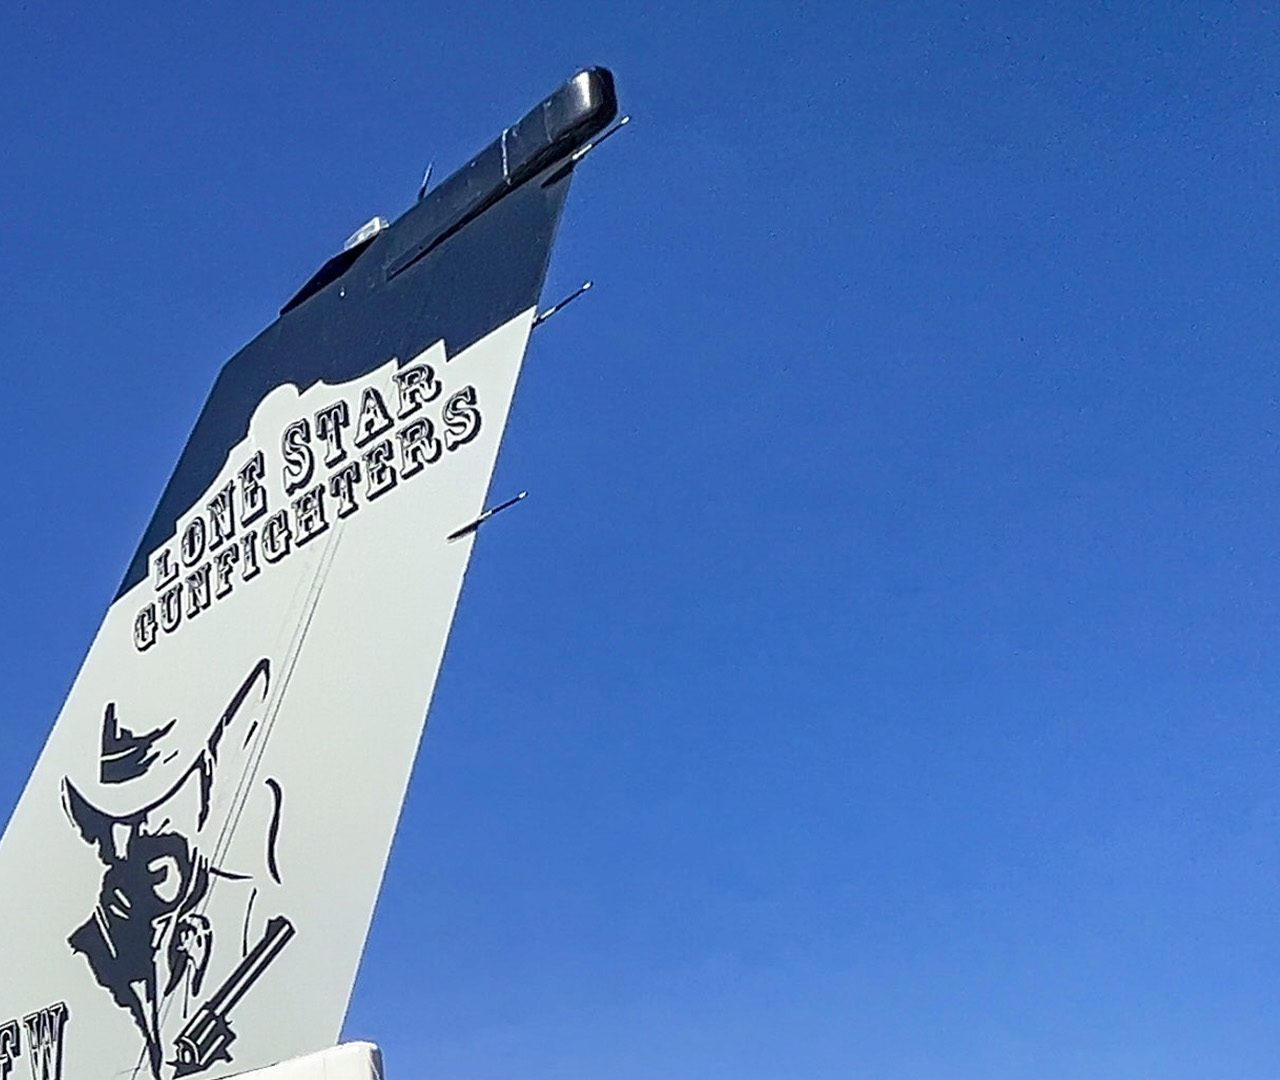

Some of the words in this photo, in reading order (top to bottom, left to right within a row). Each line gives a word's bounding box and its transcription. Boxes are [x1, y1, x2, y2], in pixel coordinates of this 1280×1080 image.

[133, 385, 483, 652] GUNFIGHTERS
[153, 449, 266, 592] LONE
[281, 362, 443, 497] STAR
